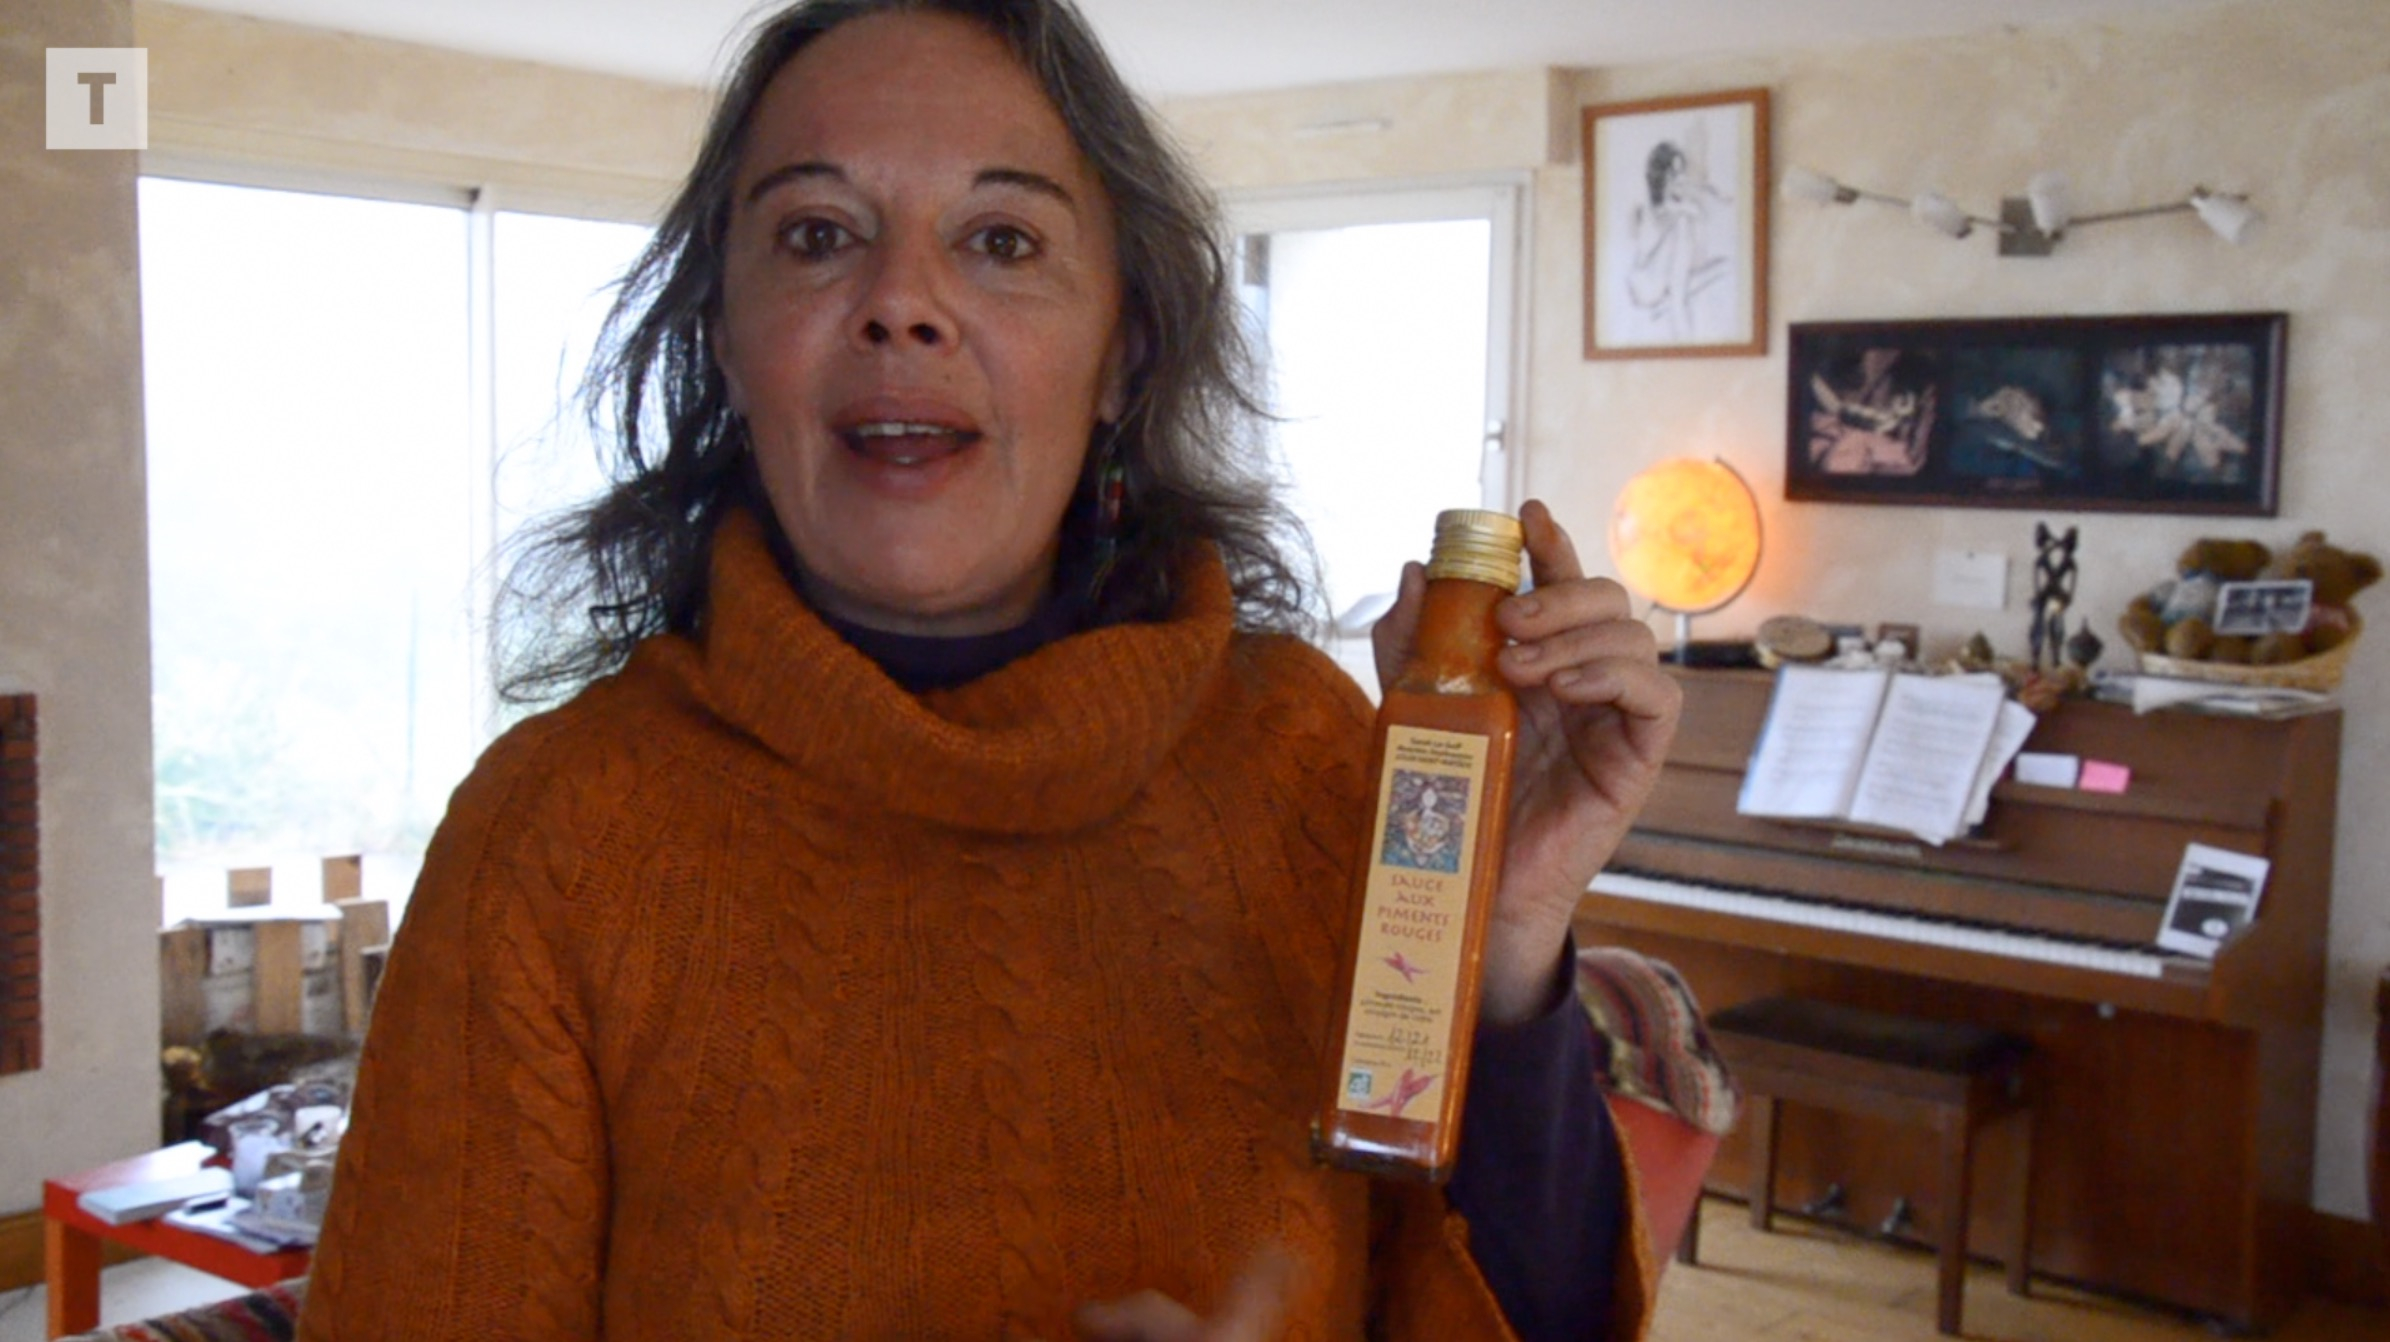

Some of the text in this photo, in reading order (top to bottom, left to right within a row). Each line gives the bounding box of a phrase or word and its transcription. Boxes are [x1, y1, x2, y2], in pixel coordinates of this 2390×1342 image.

[1391, 874, 1444, 892] SAUCE
[1396, 890, 1434, 907] AUX
[1377, 905, 1450, 927] PIMENTS
[1380, 922, 1443, 942] ROUGES
